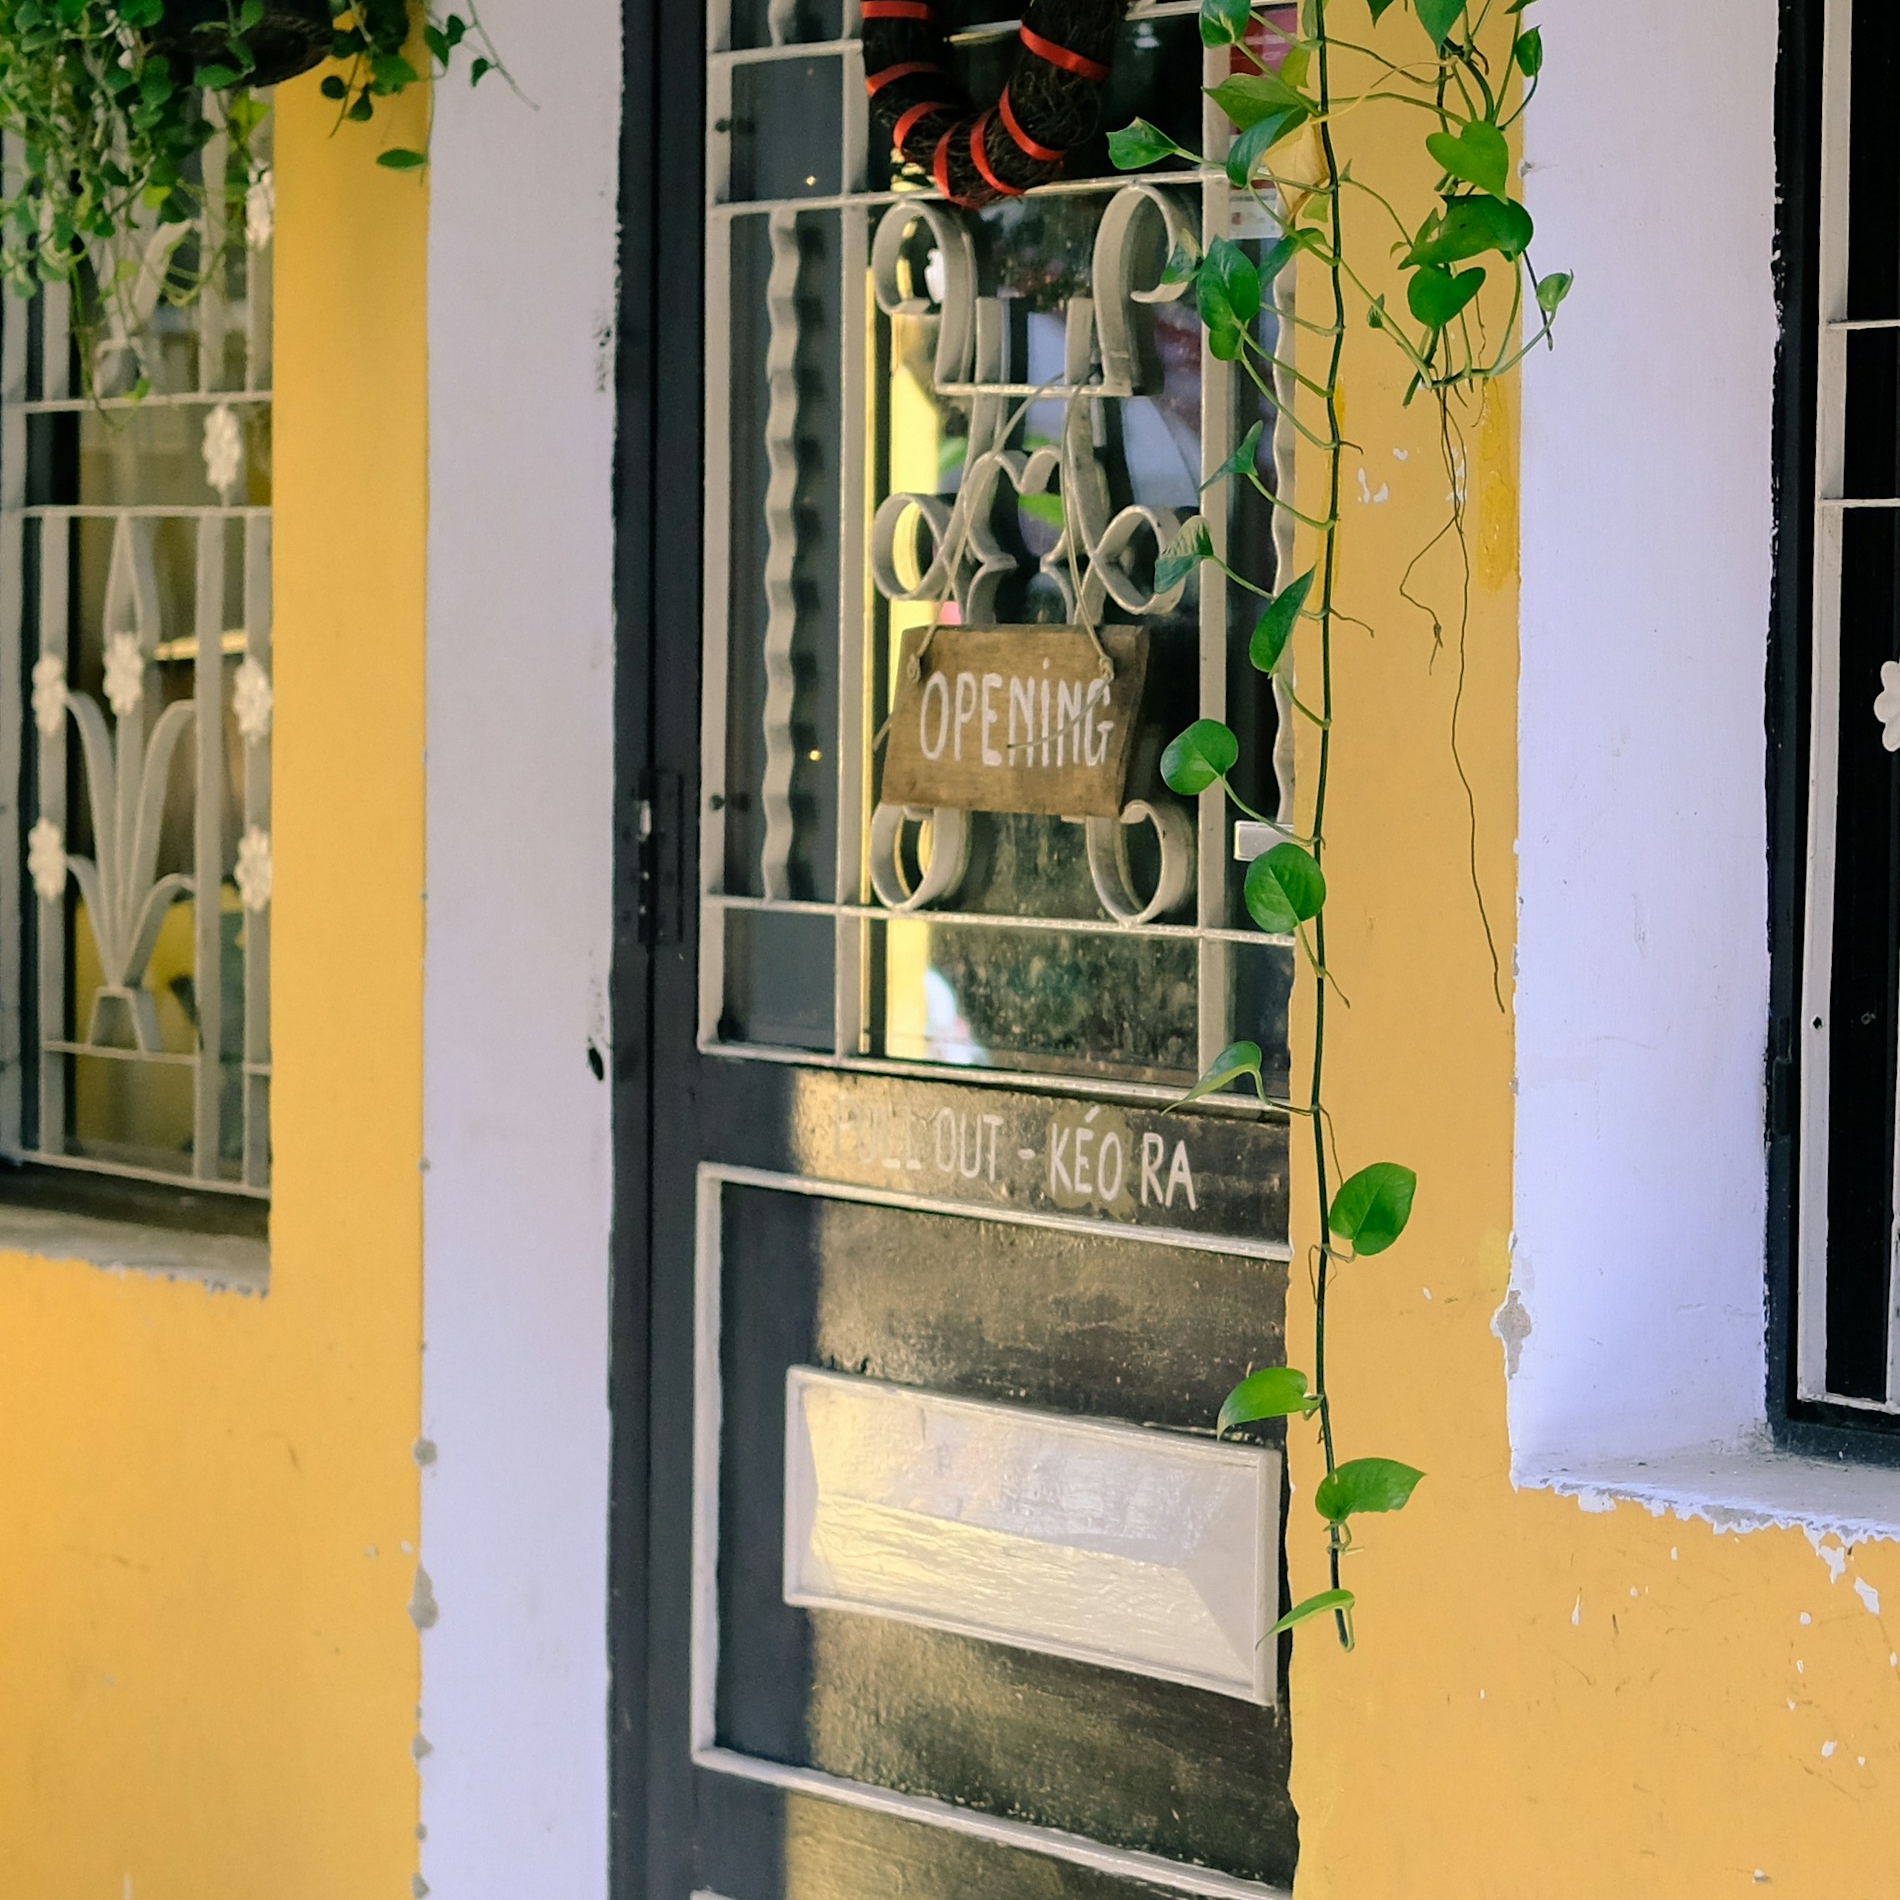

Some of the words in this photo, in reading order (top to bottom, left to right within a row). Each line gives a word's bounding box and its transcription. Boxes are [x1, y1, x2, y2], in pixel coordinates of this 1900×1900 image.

[935, 1106, 1004, 1182] OUT
[1048, 1105, 1125, 1203] KÉO
[1140, 1131, 1199, 1213] RA
